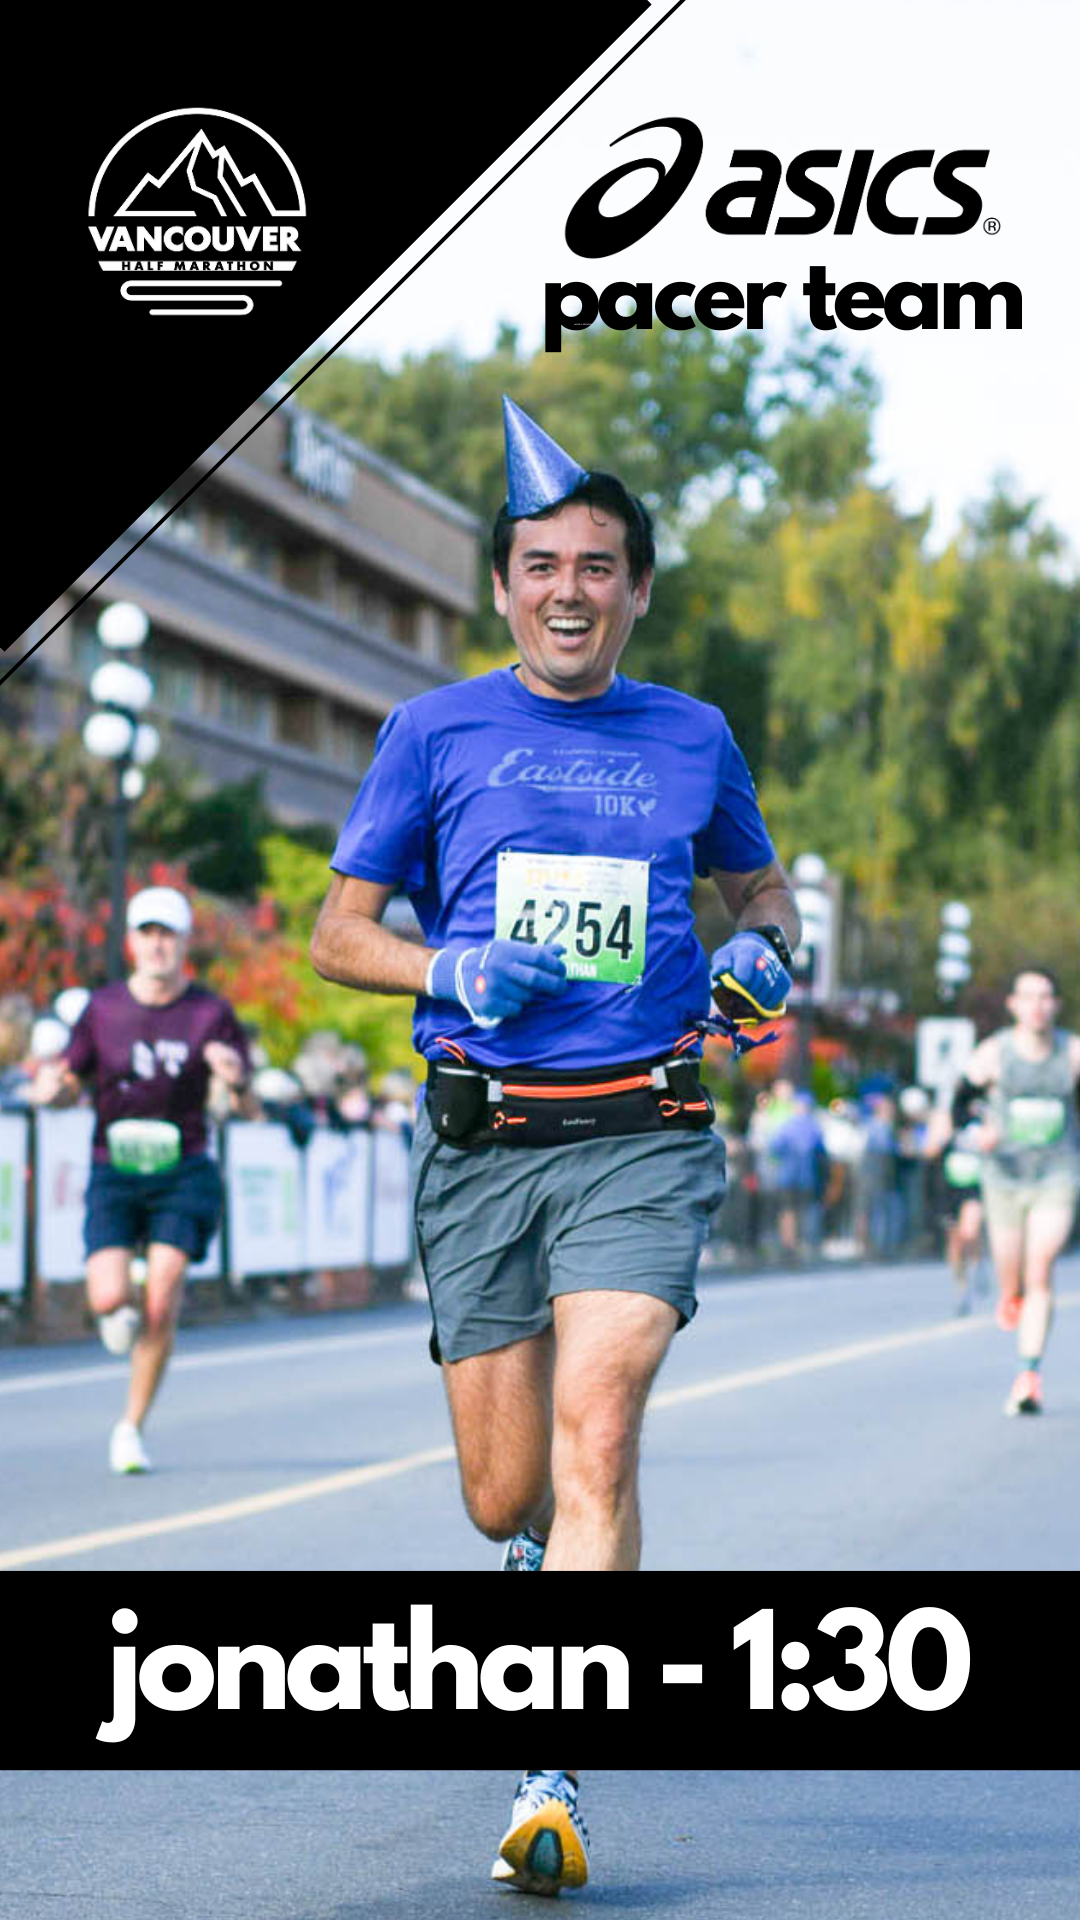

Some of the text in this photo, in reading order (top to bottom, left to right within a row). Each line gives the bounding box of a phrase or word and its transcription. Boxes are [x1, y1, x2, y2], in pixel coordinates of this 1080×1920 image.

[487, 748, 657, 788] Eastside
[594, 795, 635, 817] 10K
[510, 899, 633, 960] 4254
